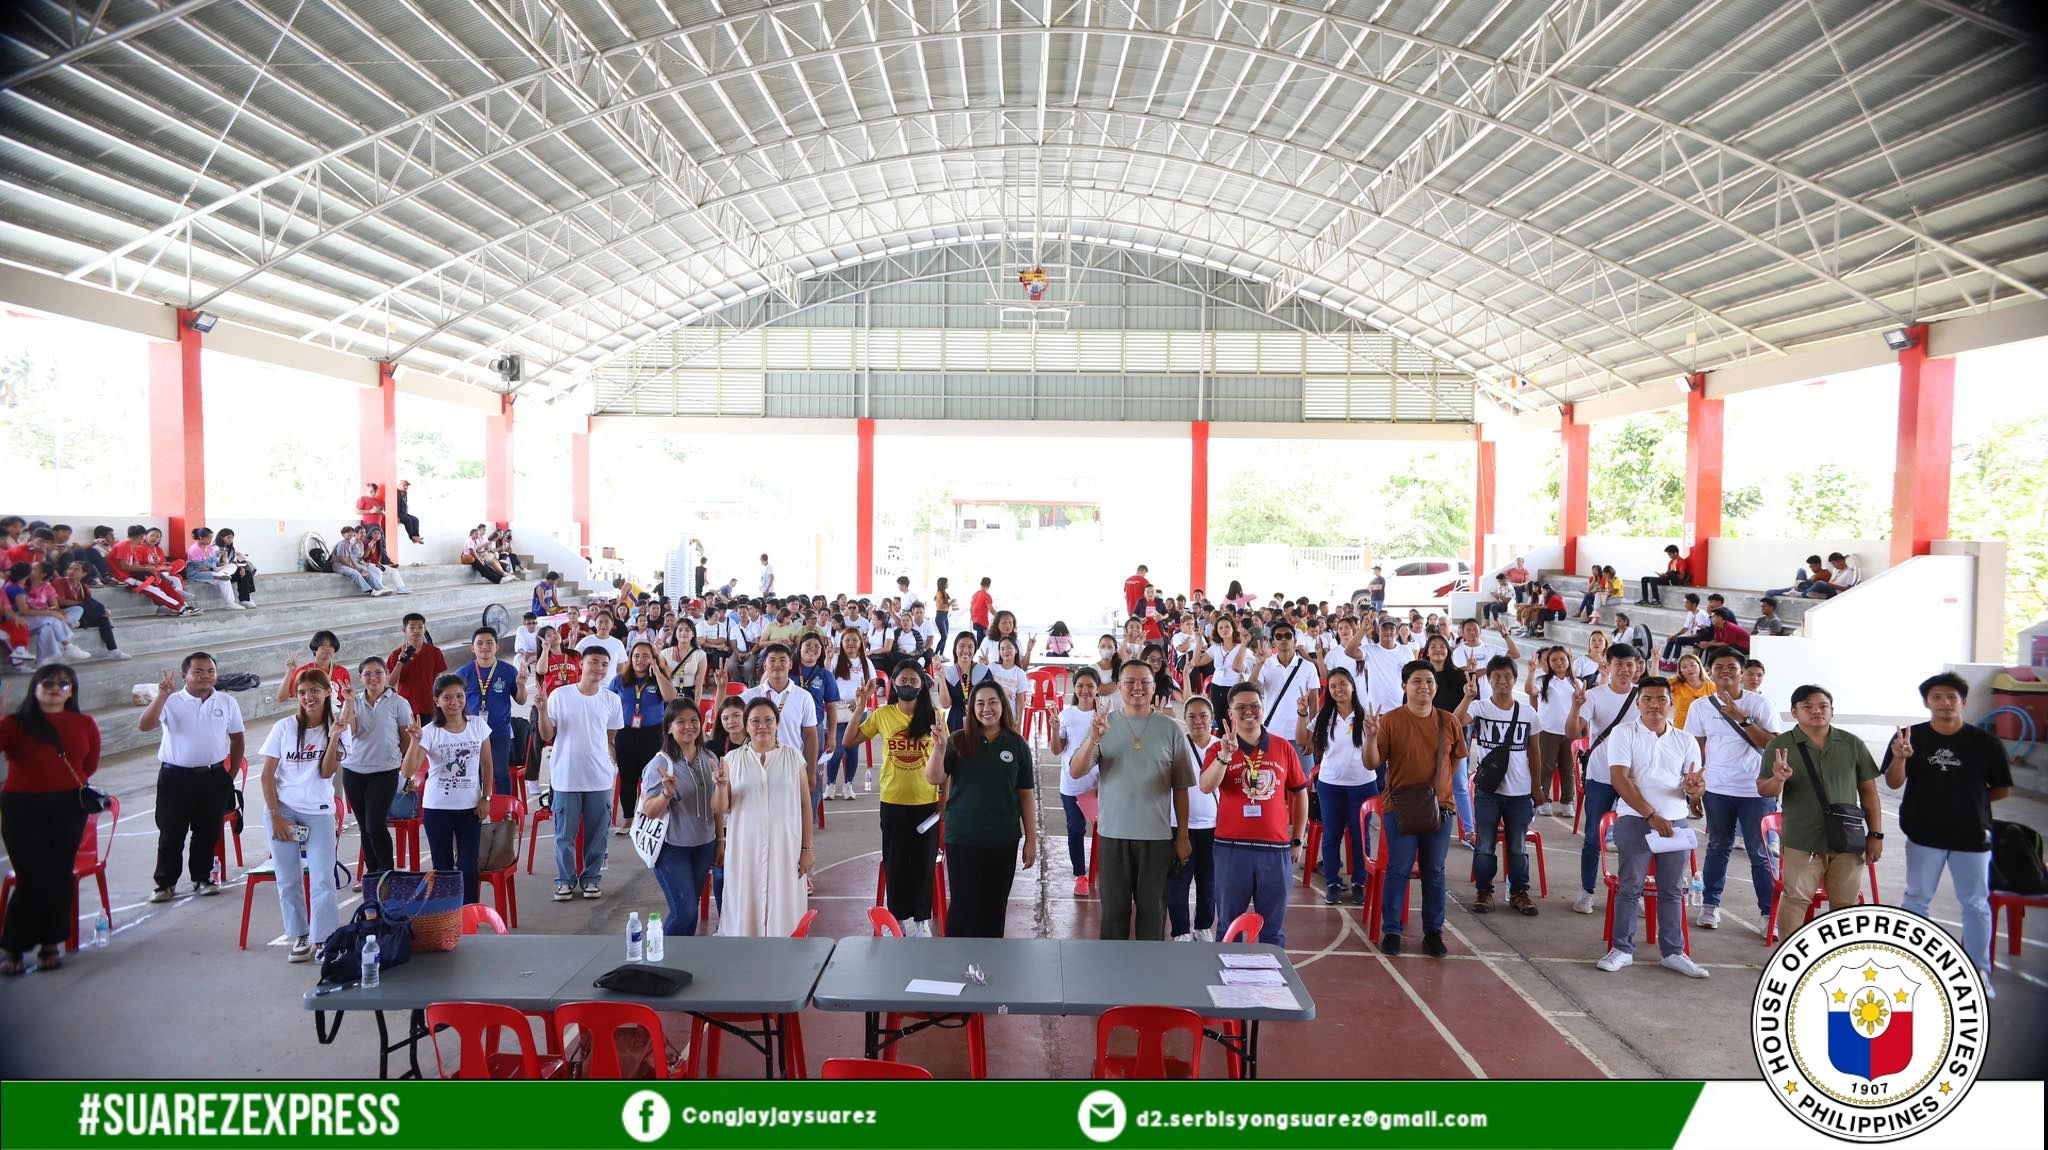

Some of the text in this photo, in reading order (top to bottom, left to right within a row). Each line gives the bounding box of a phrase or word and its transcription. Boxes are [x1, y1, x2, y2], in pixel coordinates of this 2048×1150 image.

[1480, 720, 1527, 744] NYU
[888, 739, 930, 751] BSHM
[286, 750, 324, 760] MACBET
